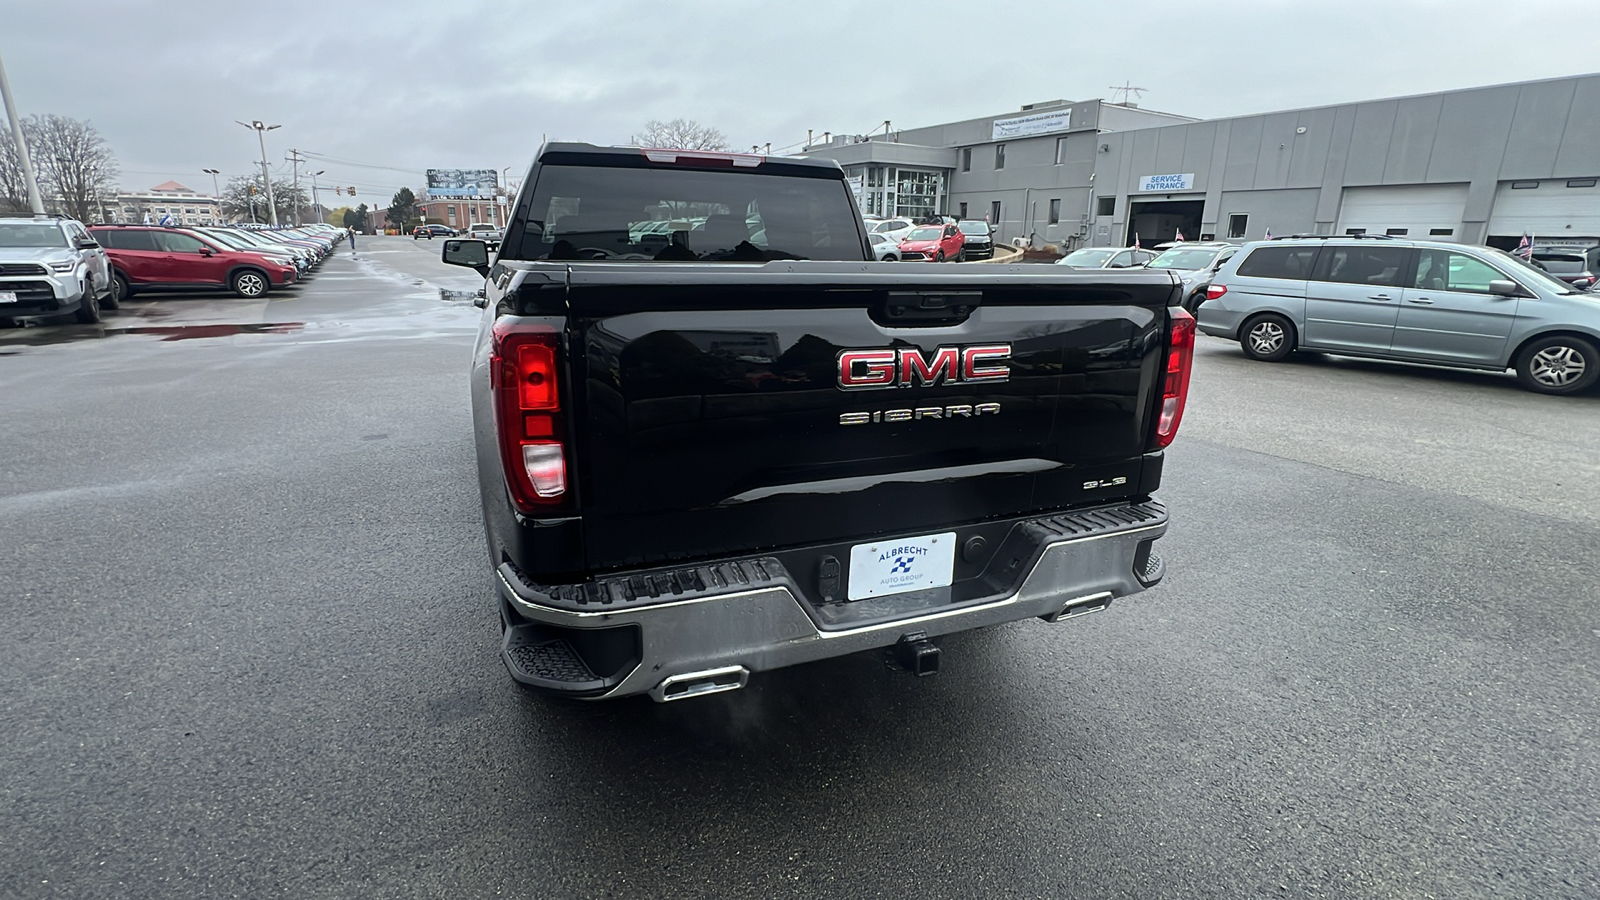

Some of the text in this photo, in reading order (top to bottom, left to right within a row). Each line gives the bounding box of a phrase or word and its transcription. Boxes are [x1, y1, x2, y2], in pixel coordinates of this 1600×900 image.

[1151, 175, 1182, 183] SERVICE
[1146, 182, 1185, 190] ENTRANCE
[835, 345, 1012, 392] GMC
[839, 402, 1001, 425] SIERRA
[879, 546, 928, 562] ALBRECHT
[880, 574, 924, 585] AUTO GROUP
